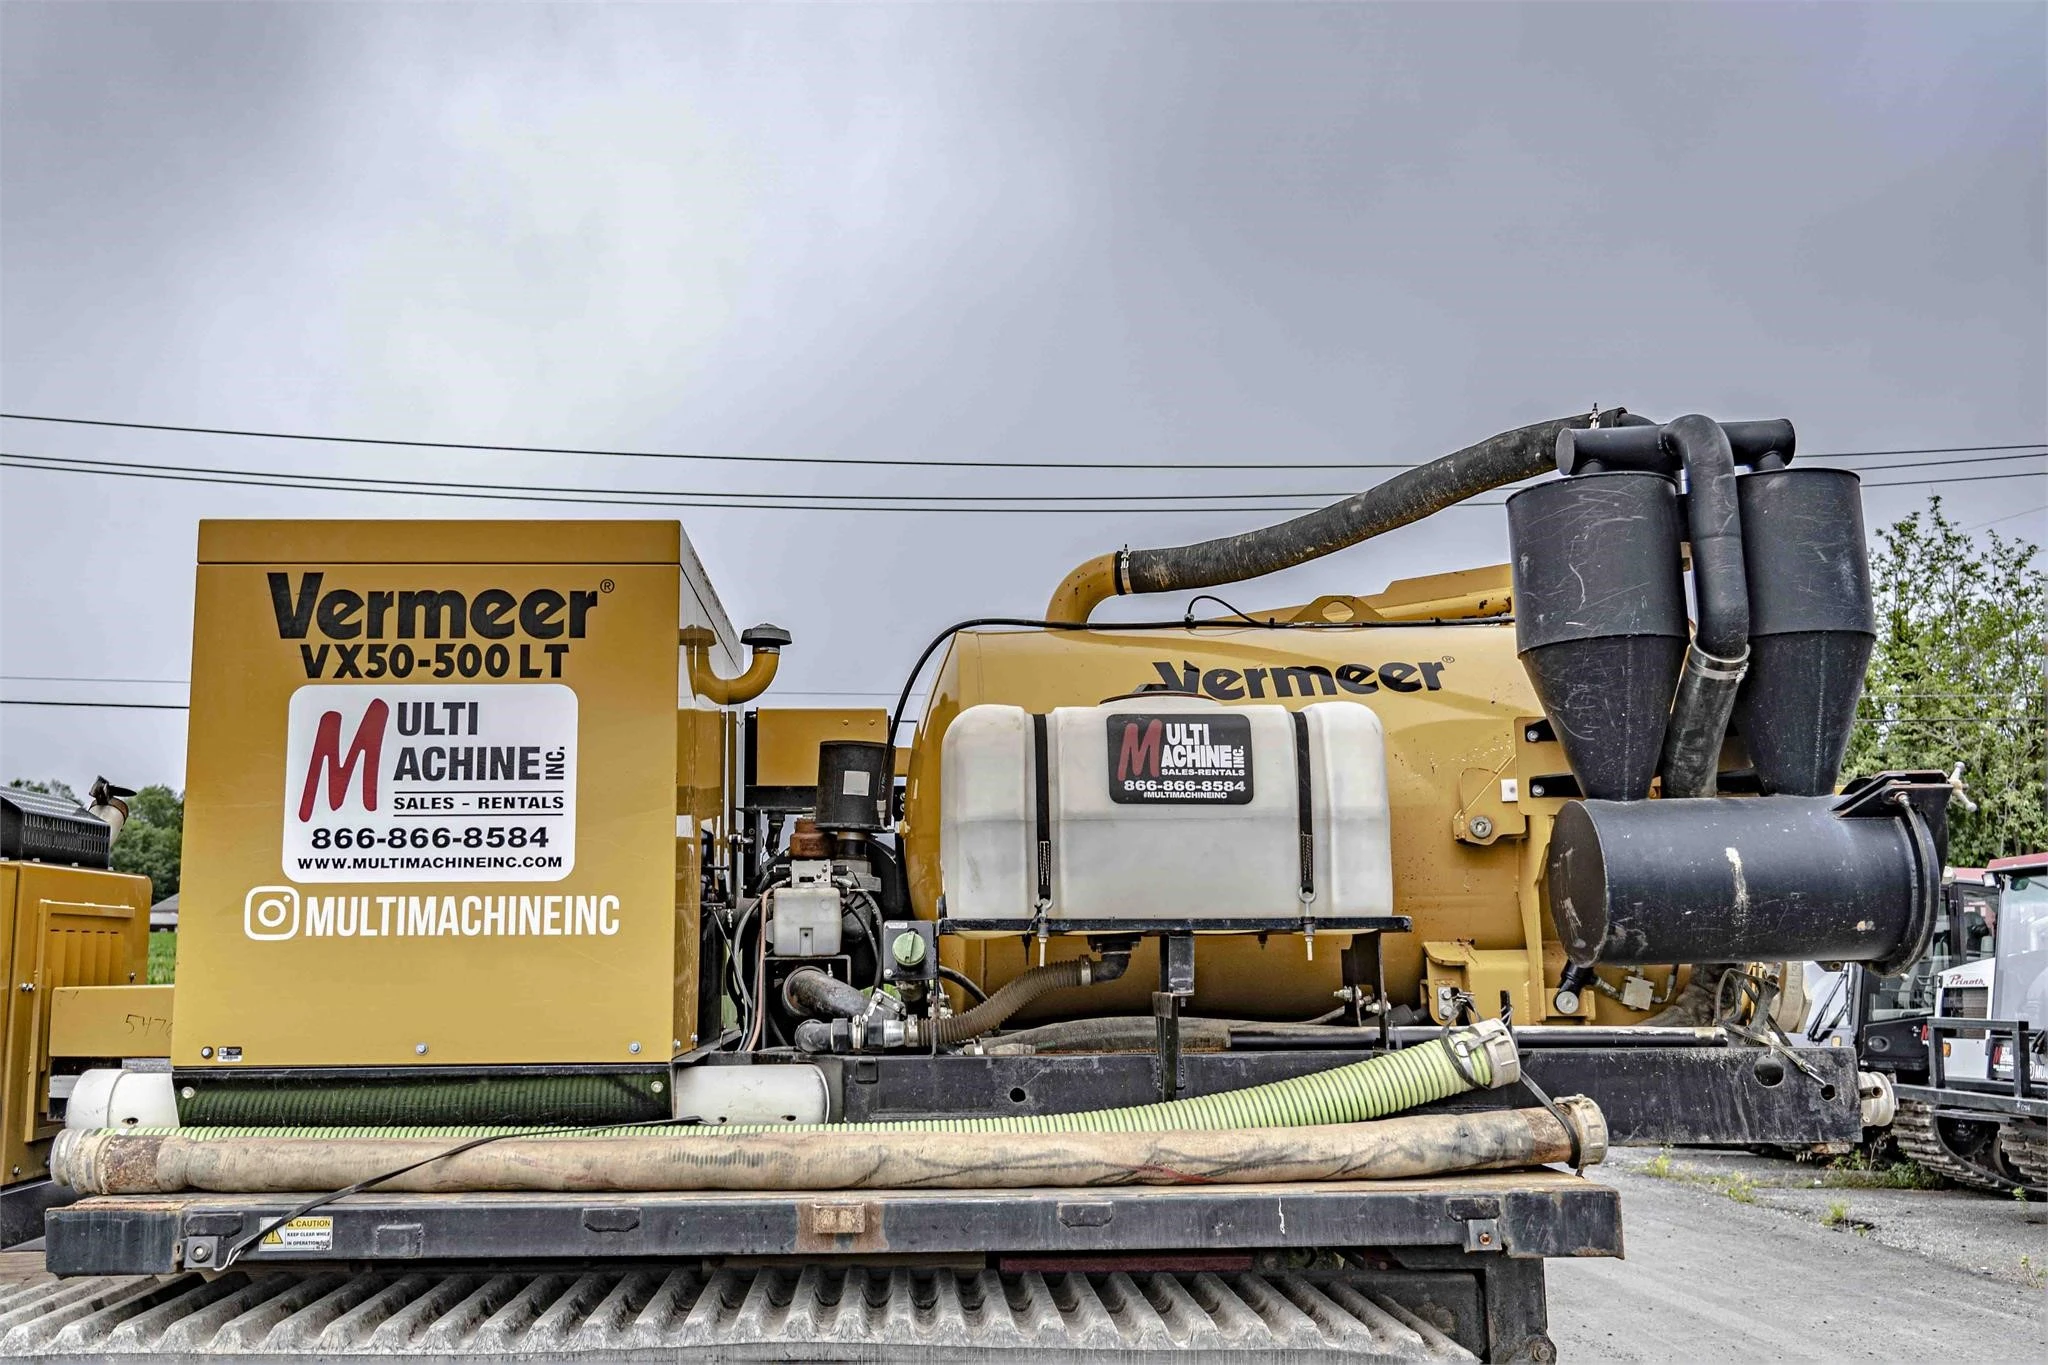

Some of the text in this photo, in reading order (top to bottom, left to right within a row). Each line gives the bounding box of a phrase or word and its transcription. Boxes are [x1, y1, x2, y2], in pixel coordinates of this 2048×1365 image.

[300, 643, 570, 679] VX50-500 LT
[545, 746, 565, 780] INC.
[1233, 745, 1245, 769] INC.
[1161, 768, 1245, 777] SALES-RENTALS
[1123, 780, 1246, 793] 866-866-8584
[1143, 791, 1228, 800] #MULTIMACHINEINC
[393, 796, 454, 810] SALES
[477, 796, 565, 810] RENTALS
[311, 827, 549, 849] 866-866-8584
[298, 856, 563, 870] WWW.MULTIMACHINEINC.COM
[305, 895, 620, 937] MULTIMACHINEINC
[296, 1220, 331, 1228] CAUTION
